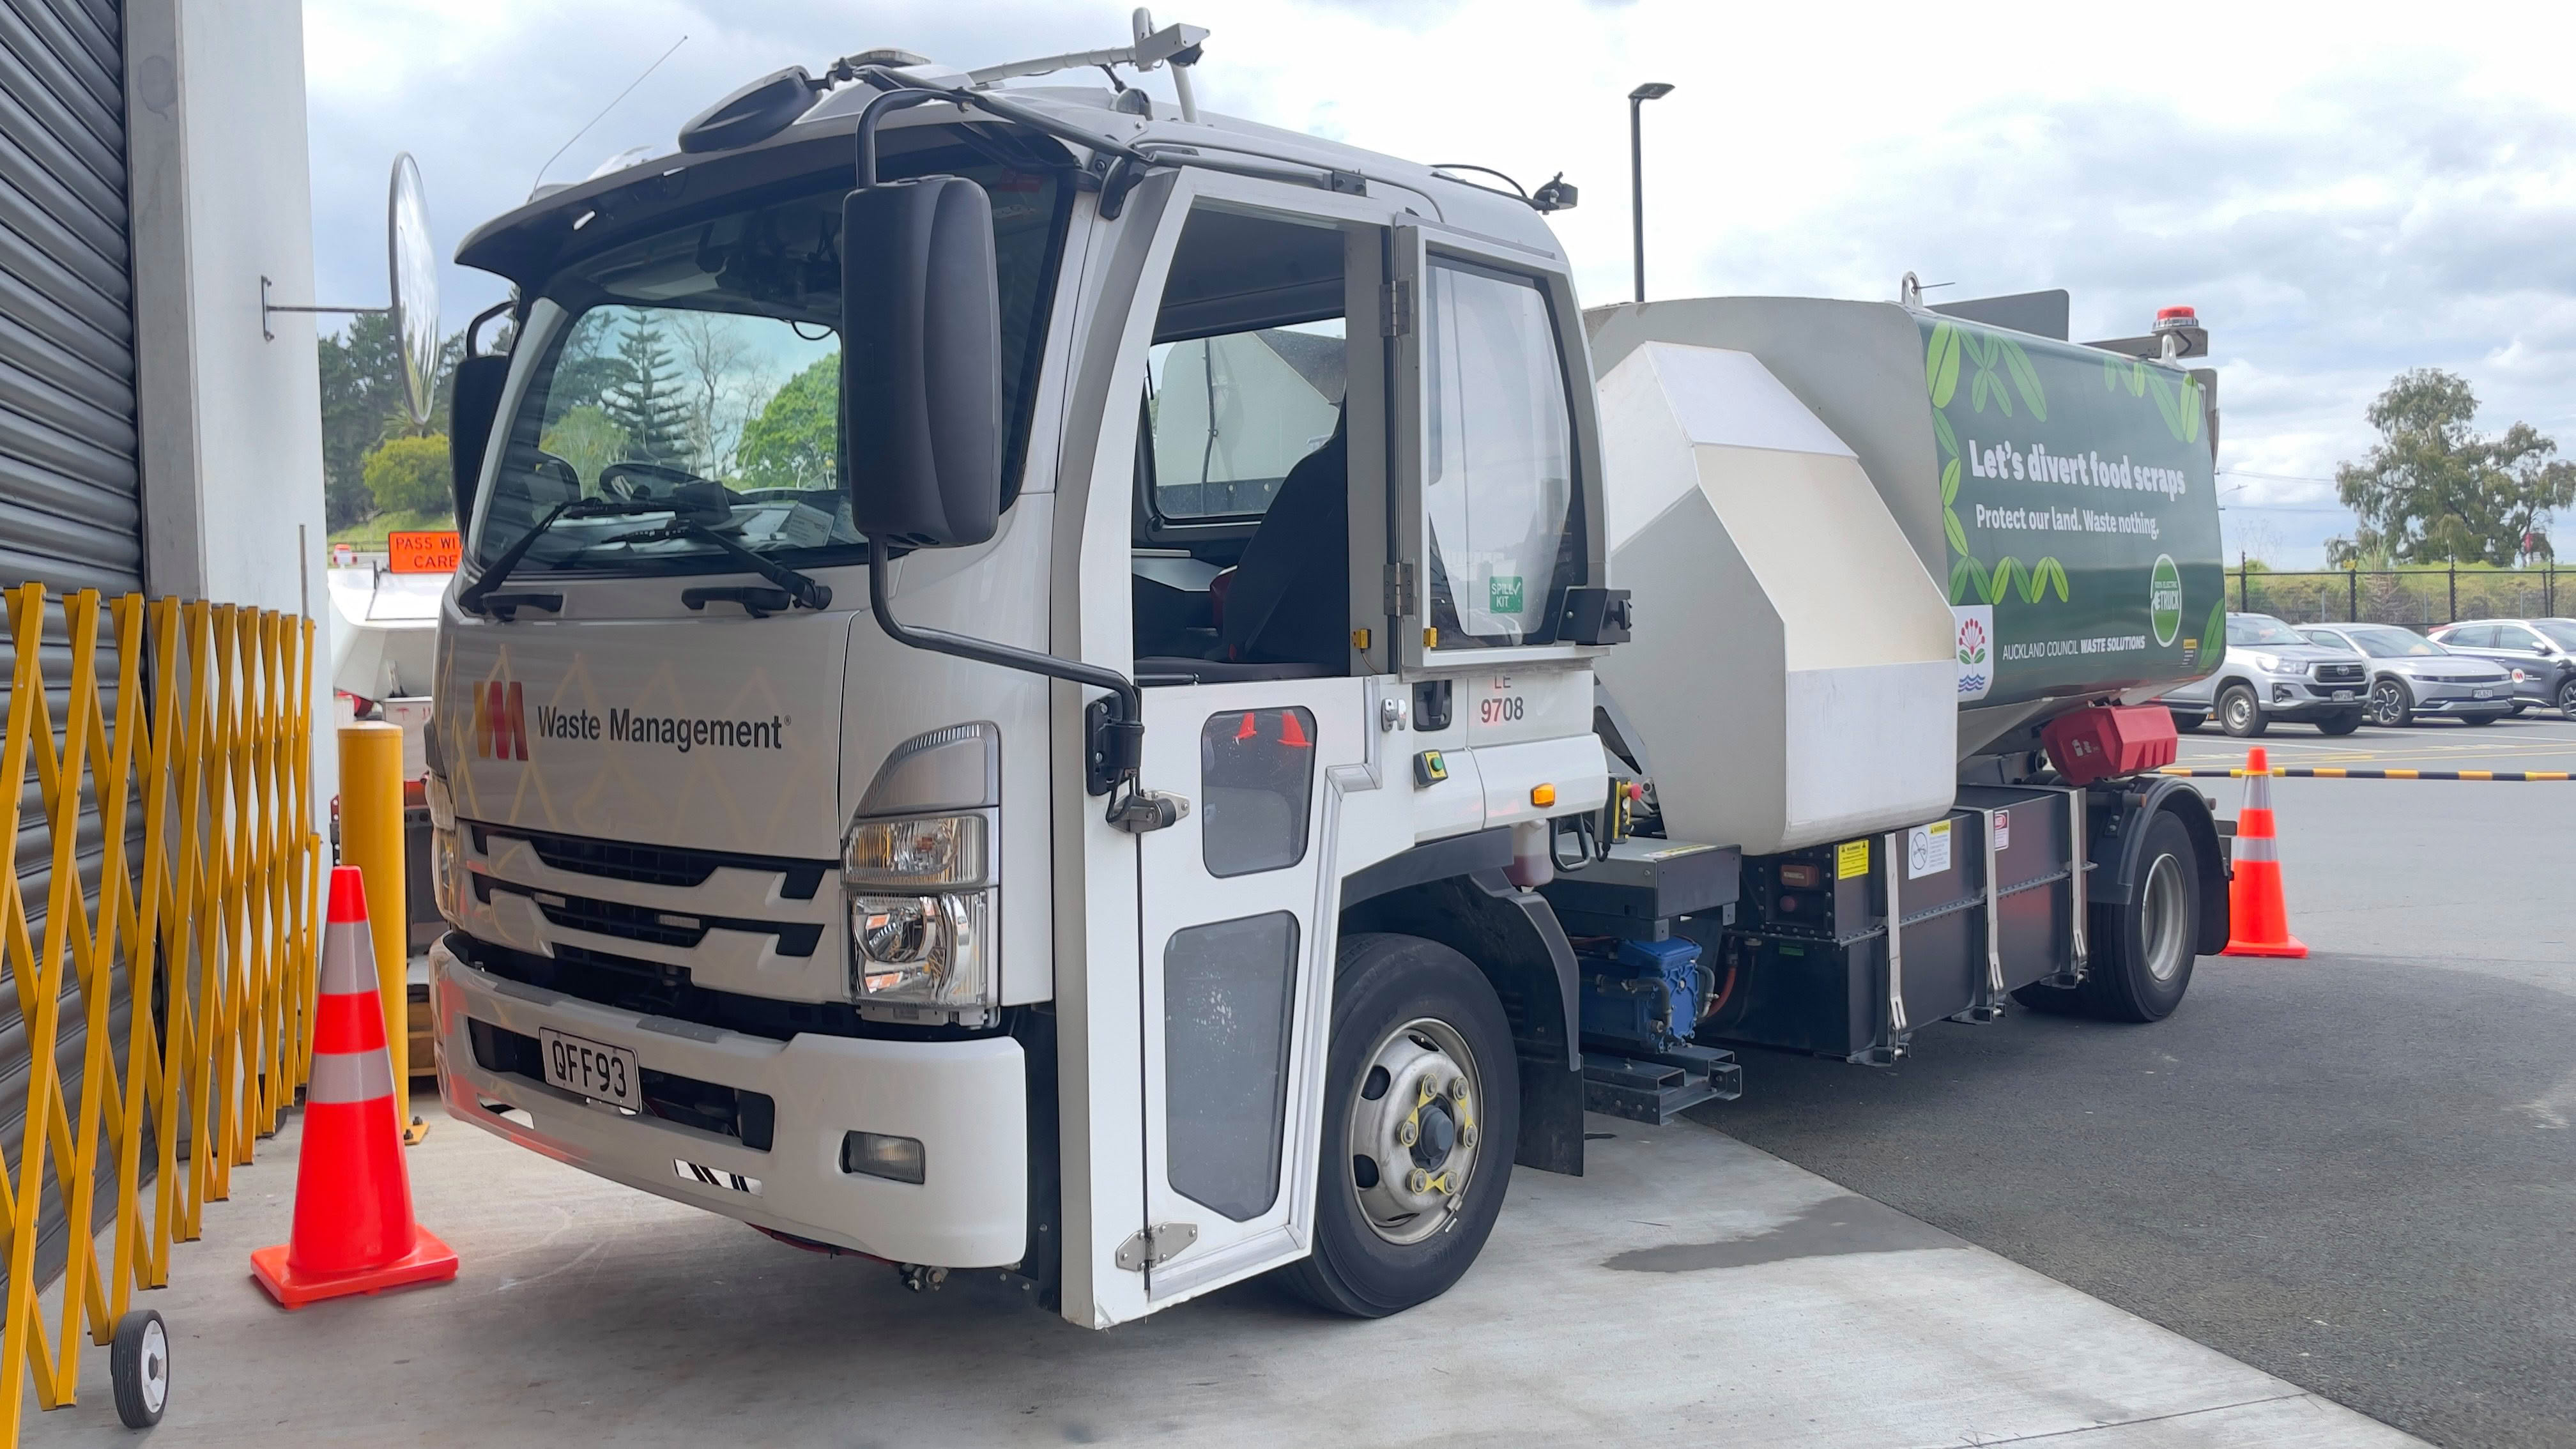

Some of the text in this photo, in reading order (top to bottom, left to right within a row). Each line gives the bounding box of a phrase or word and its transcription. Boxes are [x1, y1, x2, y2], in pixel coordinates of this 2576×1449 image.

[1969, 440, 2186, 502] Let's divert food scraps
[1975, 504, 2159, 540] Protect our land. Waste nothing.
[396, 537, 456, 550] PASS WI
[414, 554, 458, 568] CARE
[1491, 583, 1514, 595] SPILL
[1496, 595, 1509, 607] KIT
[2003, 635, 2145, 661] AUCKLAND COUNCIL WASTE SOLUTIONS
[537, 705, 601, 740] Waste
[1481, 696, 1524, 723] 9708
[552, 1040, 627, 1098] QFF93
